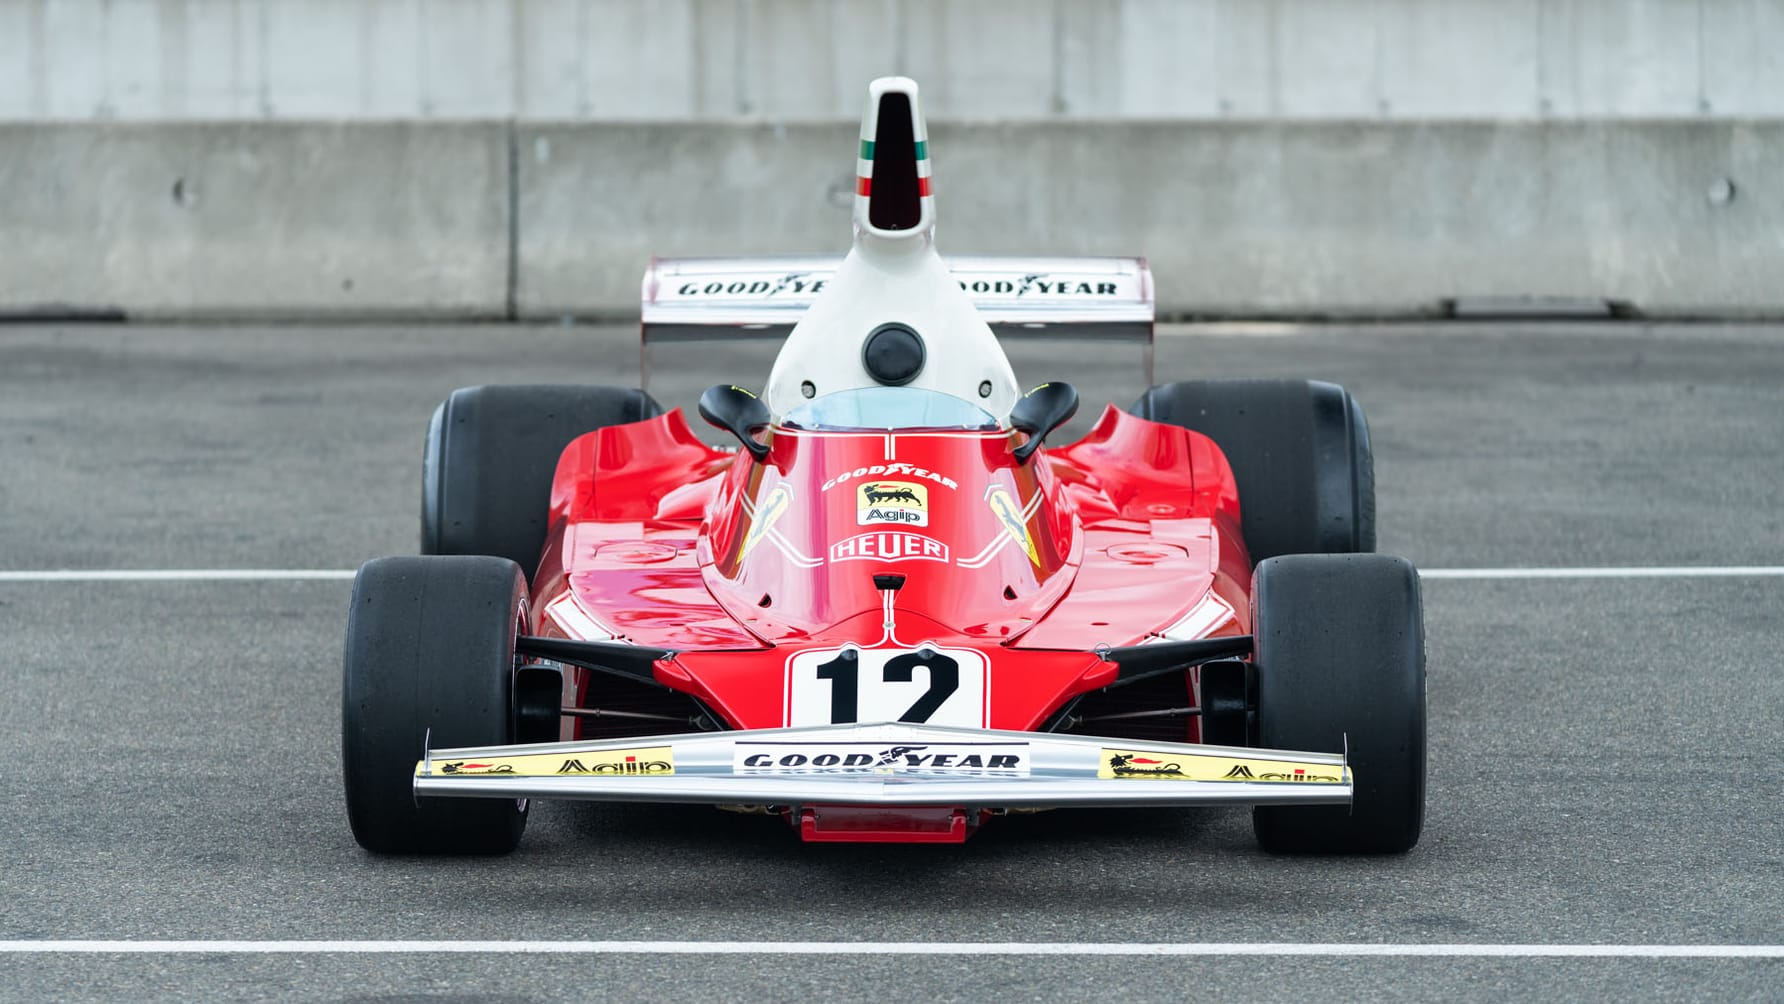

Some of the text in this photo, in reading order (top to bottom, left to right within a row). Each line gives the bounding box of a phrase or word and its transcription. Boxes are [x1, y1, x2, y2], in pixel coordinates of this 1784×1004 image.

[866, 508, 921, 523] Agip
[837, 534, 942, 558] HEUER
[817, 649, 959, 724] 12
